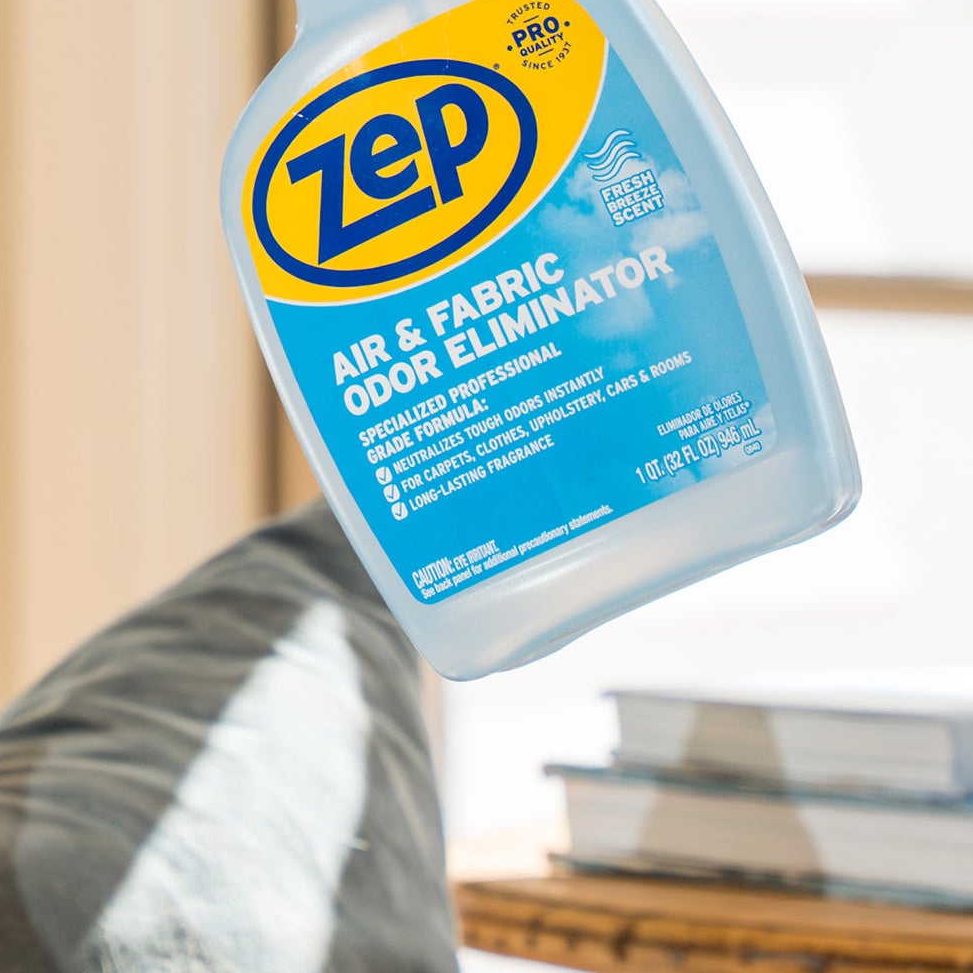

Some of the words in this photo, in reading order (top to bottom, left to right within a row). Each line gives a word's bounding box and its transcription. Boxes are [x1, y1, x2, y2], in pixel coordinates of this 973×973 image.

[506, 1, 550, 25] TRUSTED
[511, 16, 560, 48] PRO
[519, 32, 564, 57] QUALITY
[522, 59, 554, 70] SINCE
[555, 41, 572, 63] 1937
[601, 170, 655, 202] FRESH
[607, 184, 660, 214] BREEZE
[612, 194, 663, 226] SCENT
[332, 333, 393, 386] AIR
[395, 318, 427, 352] &
[426, 252, 565, 336] FABRIC
[343, 349, 443, 416] ODOR
[444, 245, 674, 369] ELIMINATOR
[358, 394, 448, 448] SPECIALIZED
[448, 342, 563, 404] PROFESSIONAL
[656, 407, 704, 436] ELIMINADOR
[702, 403, 714, 415] DE
[712, 391, 743, 411] OLORES
[366, 431, 415, 464] GRADE
[414, 398, 490, 442] FORMULA:
[392, 432, 465, 475] NEUTRALIZES
[464, 413, 504, 441] TOUGH
[503, 394, 544, 422] ODORS
[543, 366, 605, 404] INSTANTLY
[400, 474, 424, 493] FOR
[423, 450, 476, 482] CARPETS,
[475, 425, 529, 457] CLOTHES,
[529, 389, 607, 432] UPHOLSTERY,
[606, 374, 638, 398] CARS
[638, 369, 651, 383] &
[649, 350, 693, 378] ROOMS
[678, 424, 700, 440] PARA
[699, 417, 718, 433] AIRE
[716, 412, 725, 424] Y
[408, 465, 487, 512] LONG-LASTING
[486, 434, 555, 474] FRAGRANCE
[635, 467, 646, 484] 1
[644, 458, 665, 480] QT.
[663, 451, 685, 476] (32
[681, 444, 699, 464] FL
[697, 434, 721, 458] OZ)
[718, 426, 740, 449] 946
[740, 418, 761, 440] mL
[412, 557, 455, 589] CAUTION:
[452, 554, 467, 570] EYE
[466, 539, 500, 564] IRRITANT.
[420, 586, 436, 600] See
[435, 578, 453, 594] back
[452, 568, 472, 587] panel
[471, 564, 483, 576] for
[483, 545, 519, 571] additional
[518, 523, 570, 556] precautionary
[568, 504, 614, 531] statements.
